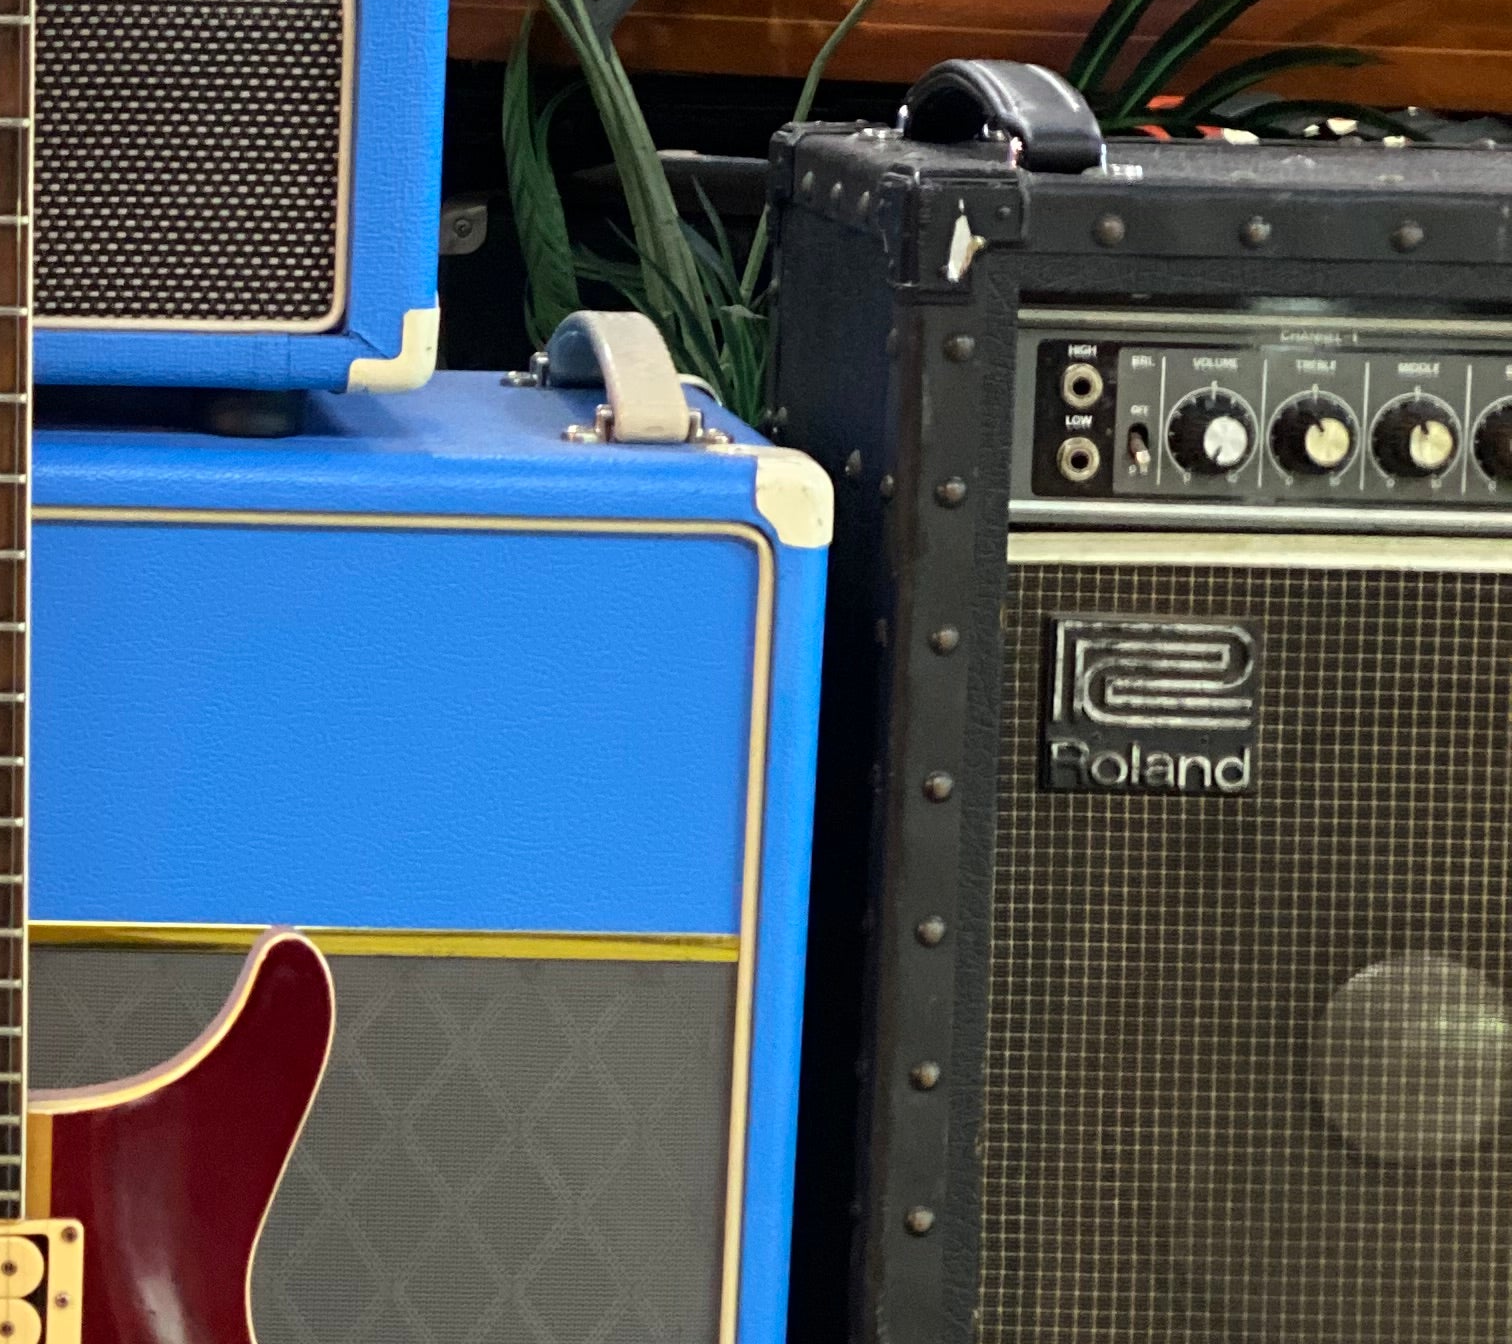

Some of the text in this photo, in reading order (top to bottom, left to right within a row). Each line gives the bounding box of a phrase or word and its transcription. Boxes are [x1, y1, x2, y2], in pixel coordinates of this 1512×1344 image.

[1067, 344, 1098, 357] HIGH
[1192, 357, 1239, 371] VOLUME
[1295, 359, 1337, 373] TREBLE
[1398, 362, 1440, 376] MIDDLE
[1130, 405, 1149, 415] OFF
[1064, 415, 1093, 429] LOW
[1049, 738, 1251, 792] Roland
